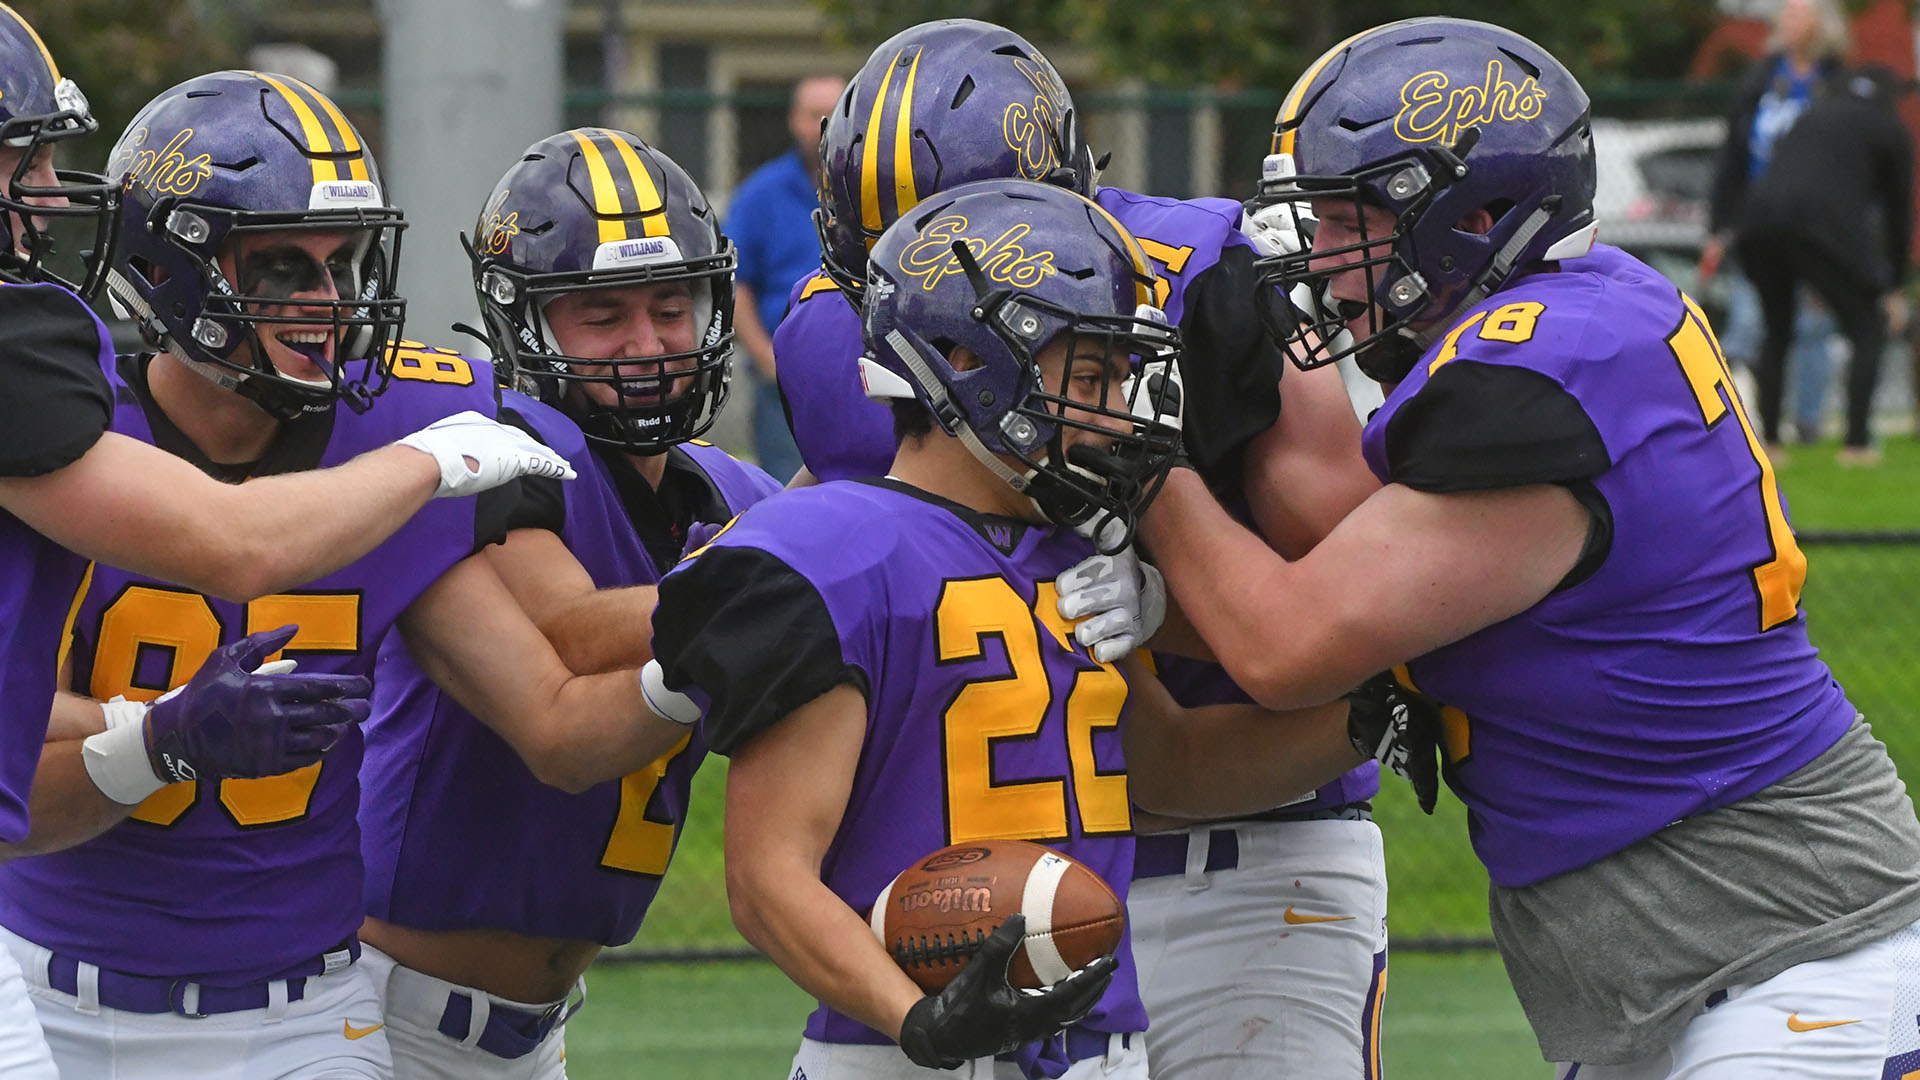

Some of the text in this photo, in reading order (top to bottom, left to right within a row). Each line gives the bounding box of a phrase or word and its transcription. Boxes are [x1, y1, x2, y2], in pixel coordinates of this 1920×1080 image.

[1393, 59, 1548, 148] Ephs
[328, 184, 369, 199] WILLIAMS
[618, 239, 664, 259] WILLIAMS
[899, 215, 1056, 291] Ephs
[932, 573, 1136, 848] 22
[162, 752, 183, 781] CUTT
[901, 887, 993, 913] Wilson
